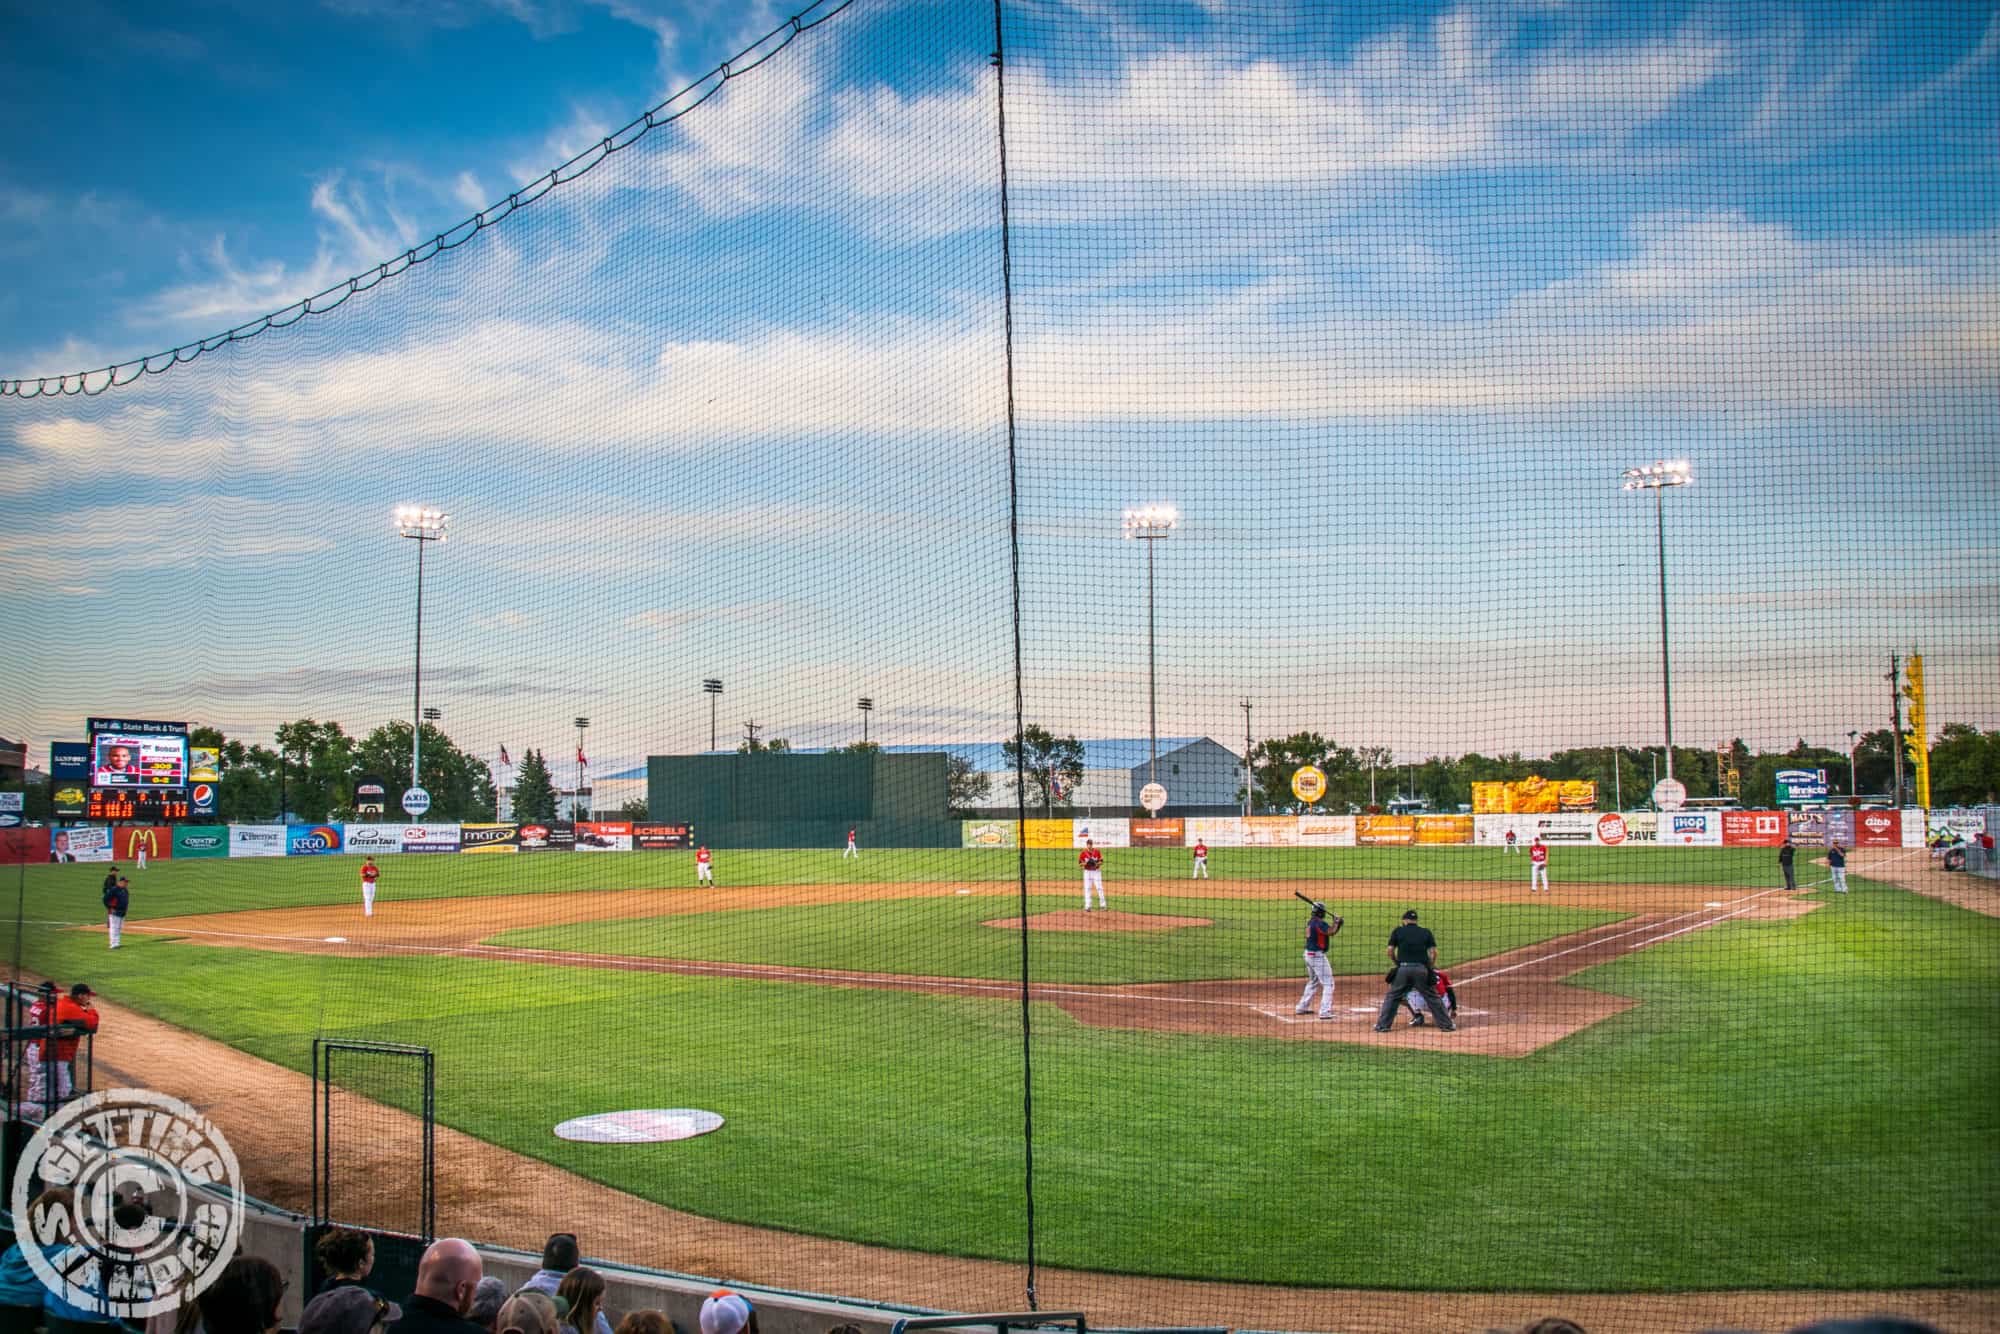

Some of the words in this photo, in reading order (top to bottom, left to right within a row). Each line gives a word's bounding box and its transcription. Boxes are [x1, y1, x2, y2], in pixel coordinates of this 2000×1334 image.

[122, 722, 142, 730] State
[143, 724, 162, 732] Bank
[464, 831, 514, 840] marco
[633, 827, 686, 835] SCHEELS
[1626, 831, 1656, 841] SAVE
[292, 838, 326, 849] KFGO
